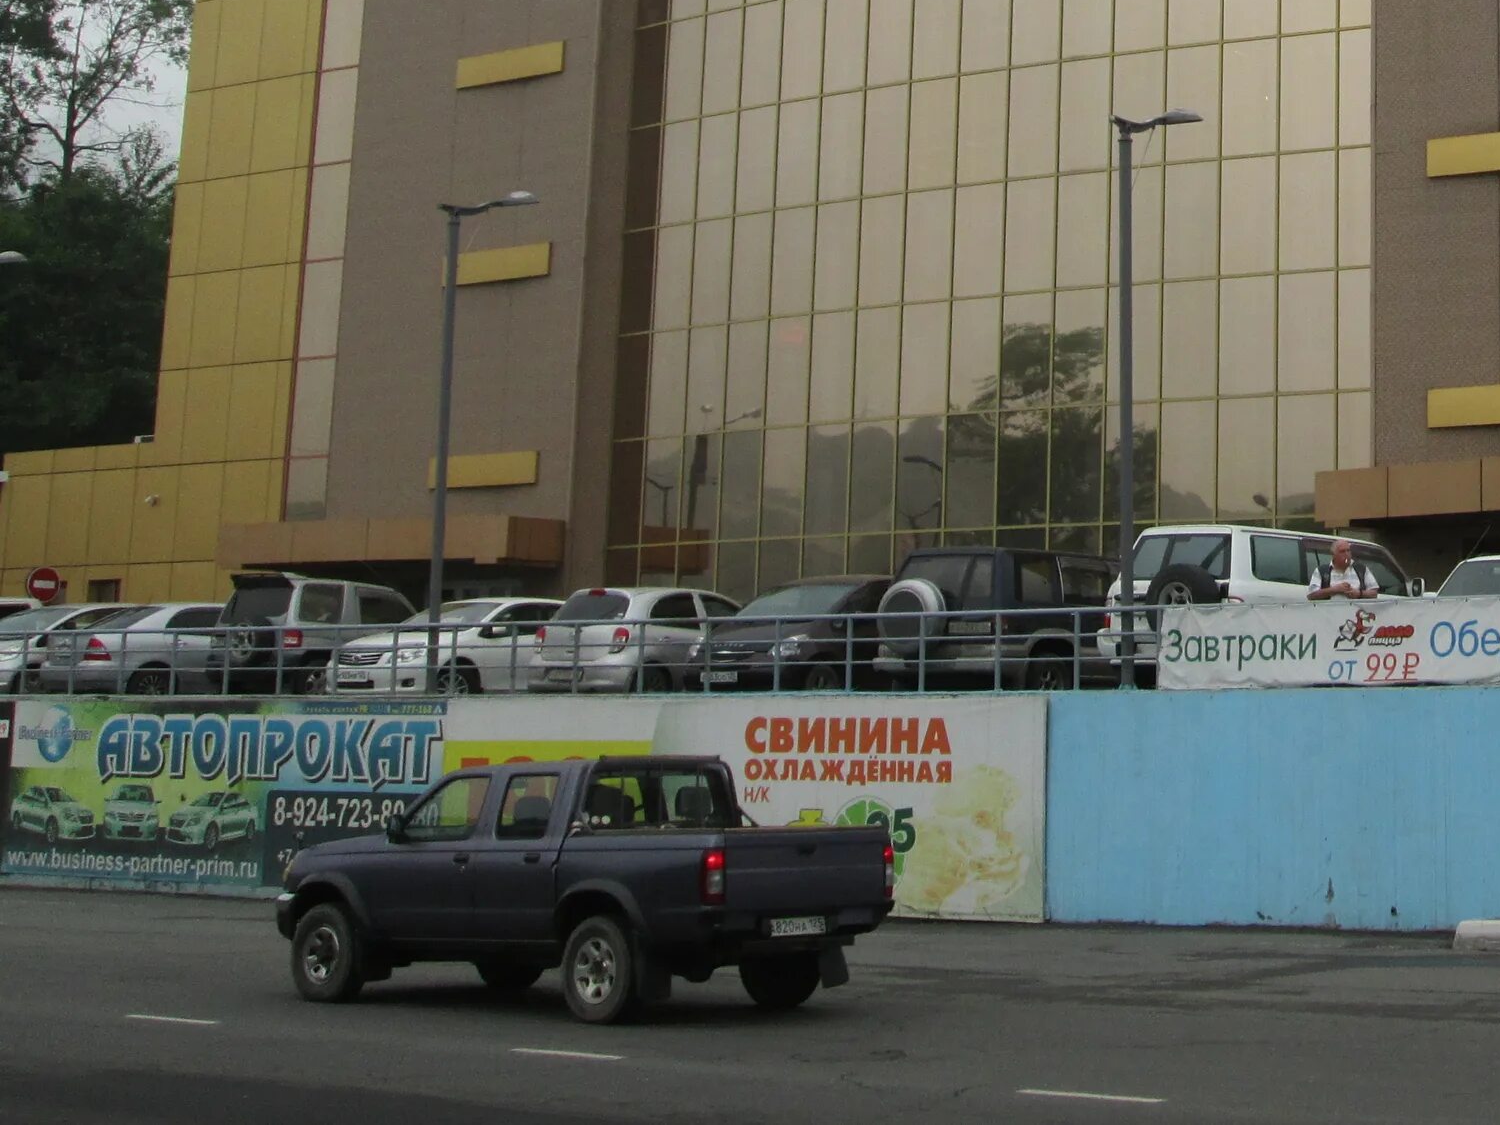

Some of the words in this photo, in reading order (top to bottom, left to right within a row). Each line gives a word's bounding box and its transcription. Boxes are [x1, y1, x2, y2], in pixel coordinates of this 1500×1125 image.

[1164, 628, 1317, 672] Завтраки
[97, 714, 443, 790] АВТОПРОКАТ
[745, 716, 952, 755] СВИНИНА
[744, 755, 952, 786] ОХЛАЖДЁННАЯ
[744, 786, 770, 803] Н/К
[8, 847, 258, 879] www.business-partner-prim.ru
